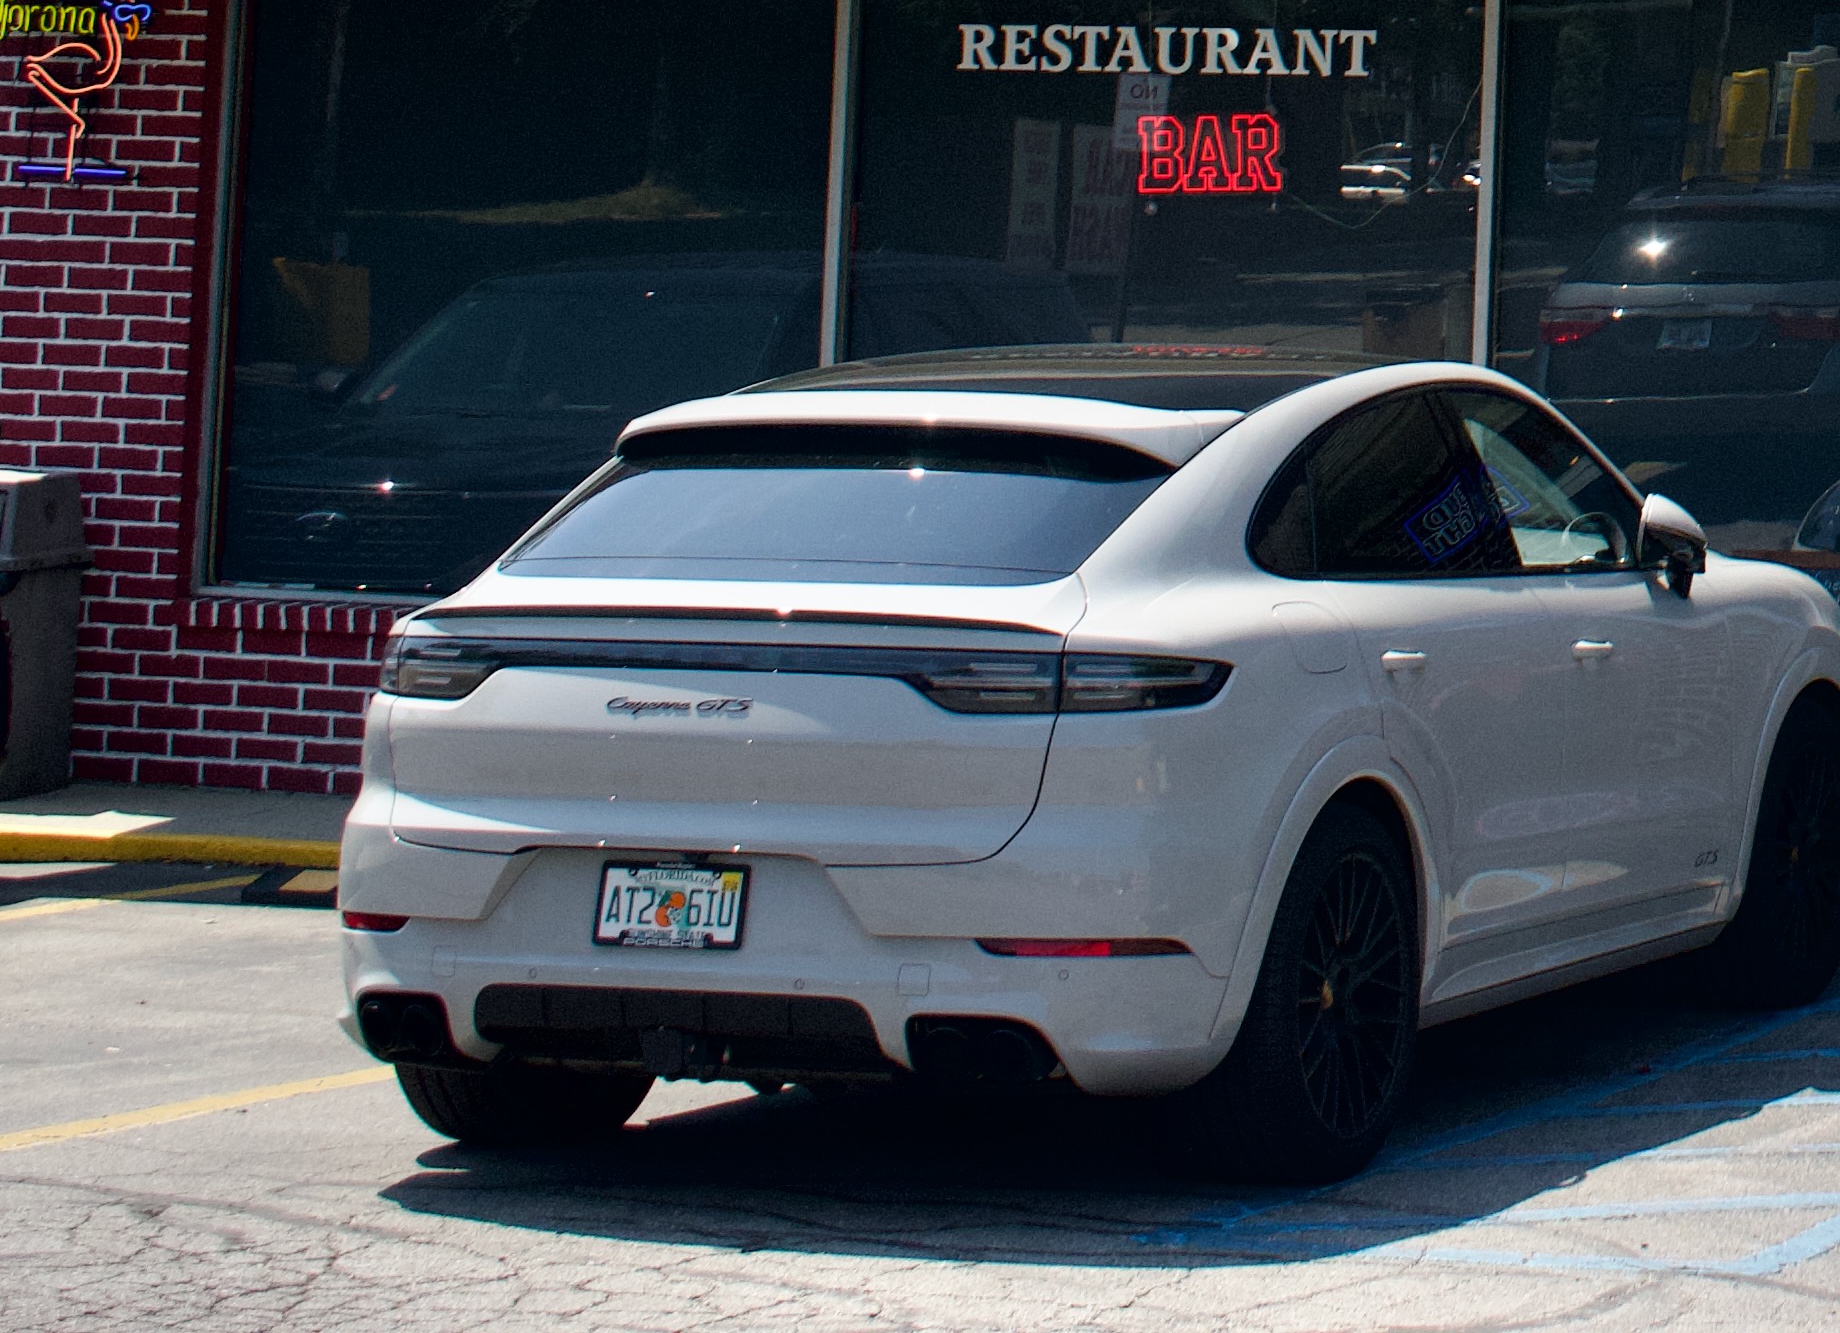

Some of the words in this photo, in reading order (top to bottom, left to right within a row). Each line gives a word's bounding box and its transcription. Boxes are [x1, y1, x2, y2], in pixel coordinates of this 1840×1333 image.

[956, 23, 1378, 78] RESTAURANT
[1137, 113, 1284, 195] BAR
[607, 696, 691, 715] Cayenne
[696, 697, 753, 712] GTS
[605, 884, 656, 925] AT2
